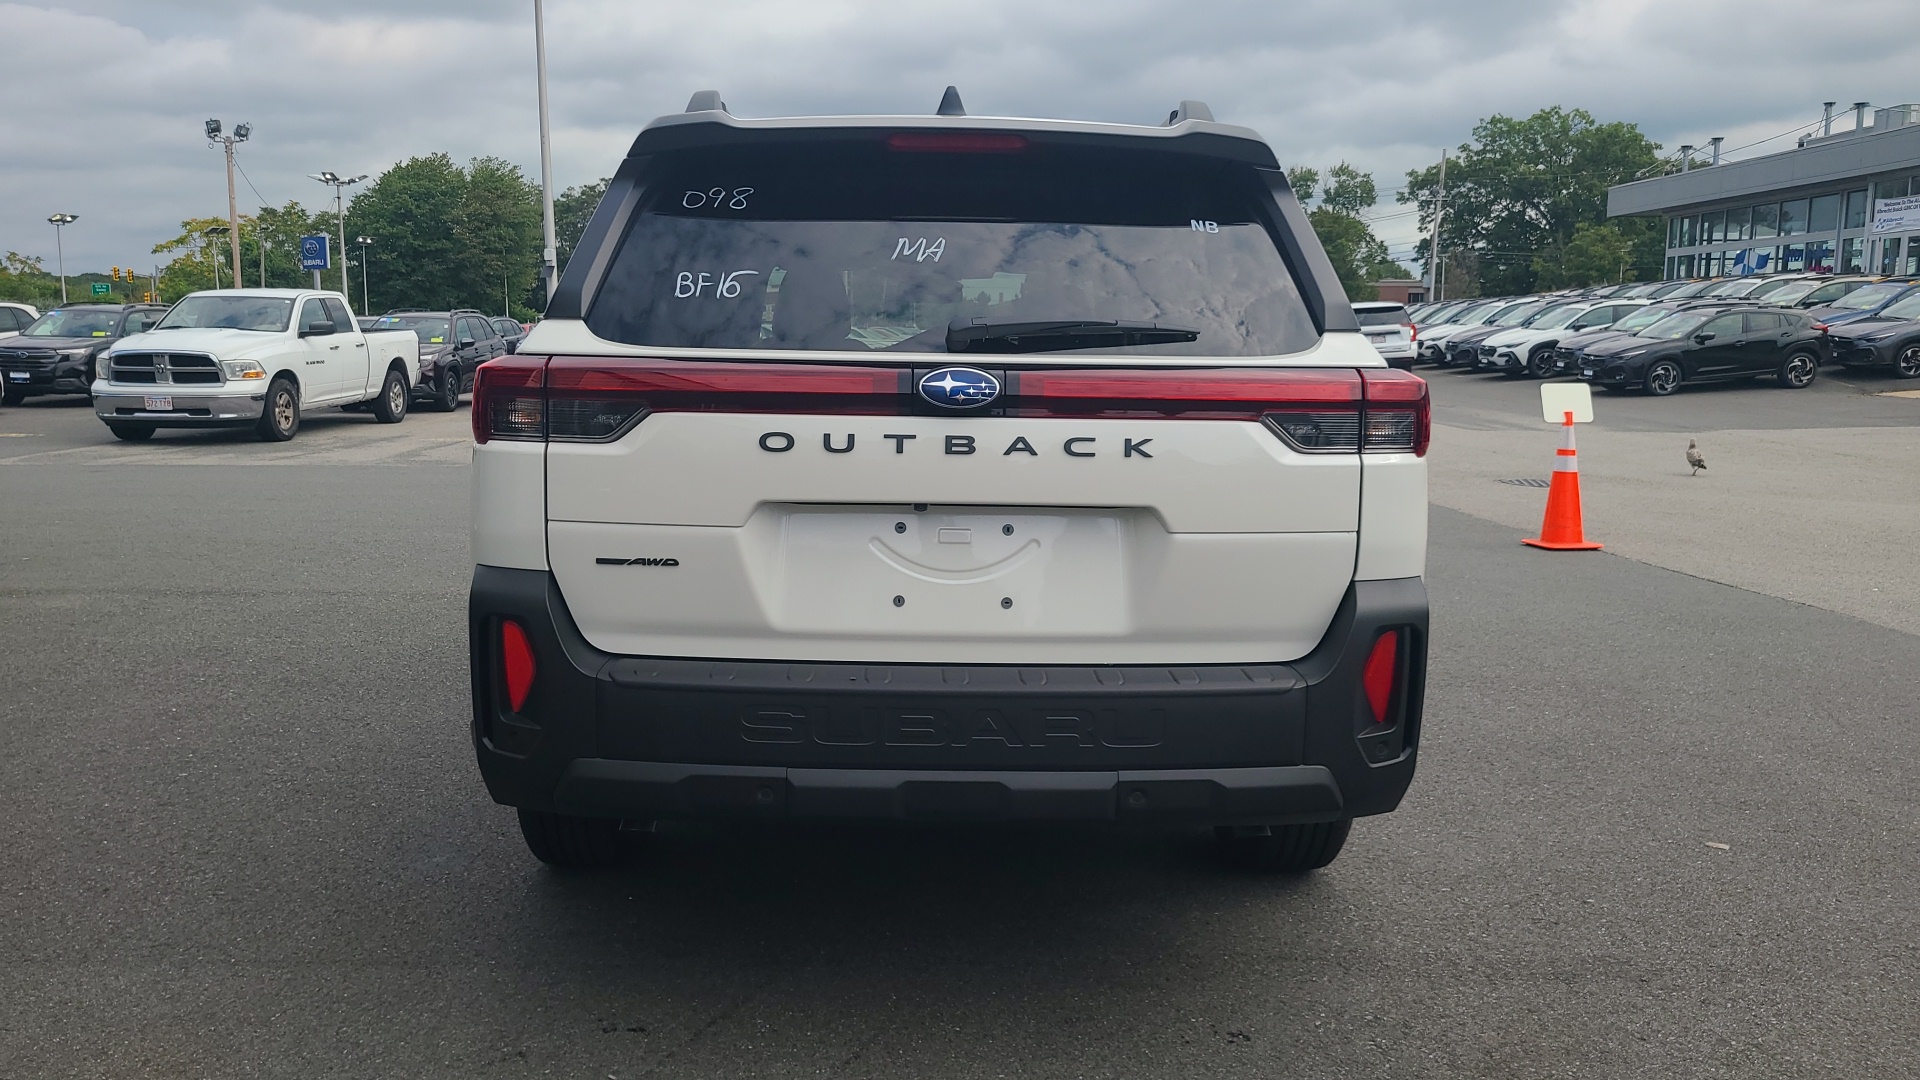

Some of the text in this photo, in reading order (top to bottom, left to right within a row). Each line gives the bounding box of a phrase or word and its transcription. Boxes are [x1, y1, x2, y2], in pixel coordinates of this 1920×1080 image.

[682, 187, 755, 210] 098
[1190, 219, 1219, 233] NB
[891, 237, 946, 262] MA
[758, 431, 1154, 458] OUTBACK
[626, 557, 680, 566] AWD
[741, 705, 1167, 748] SUBARU
